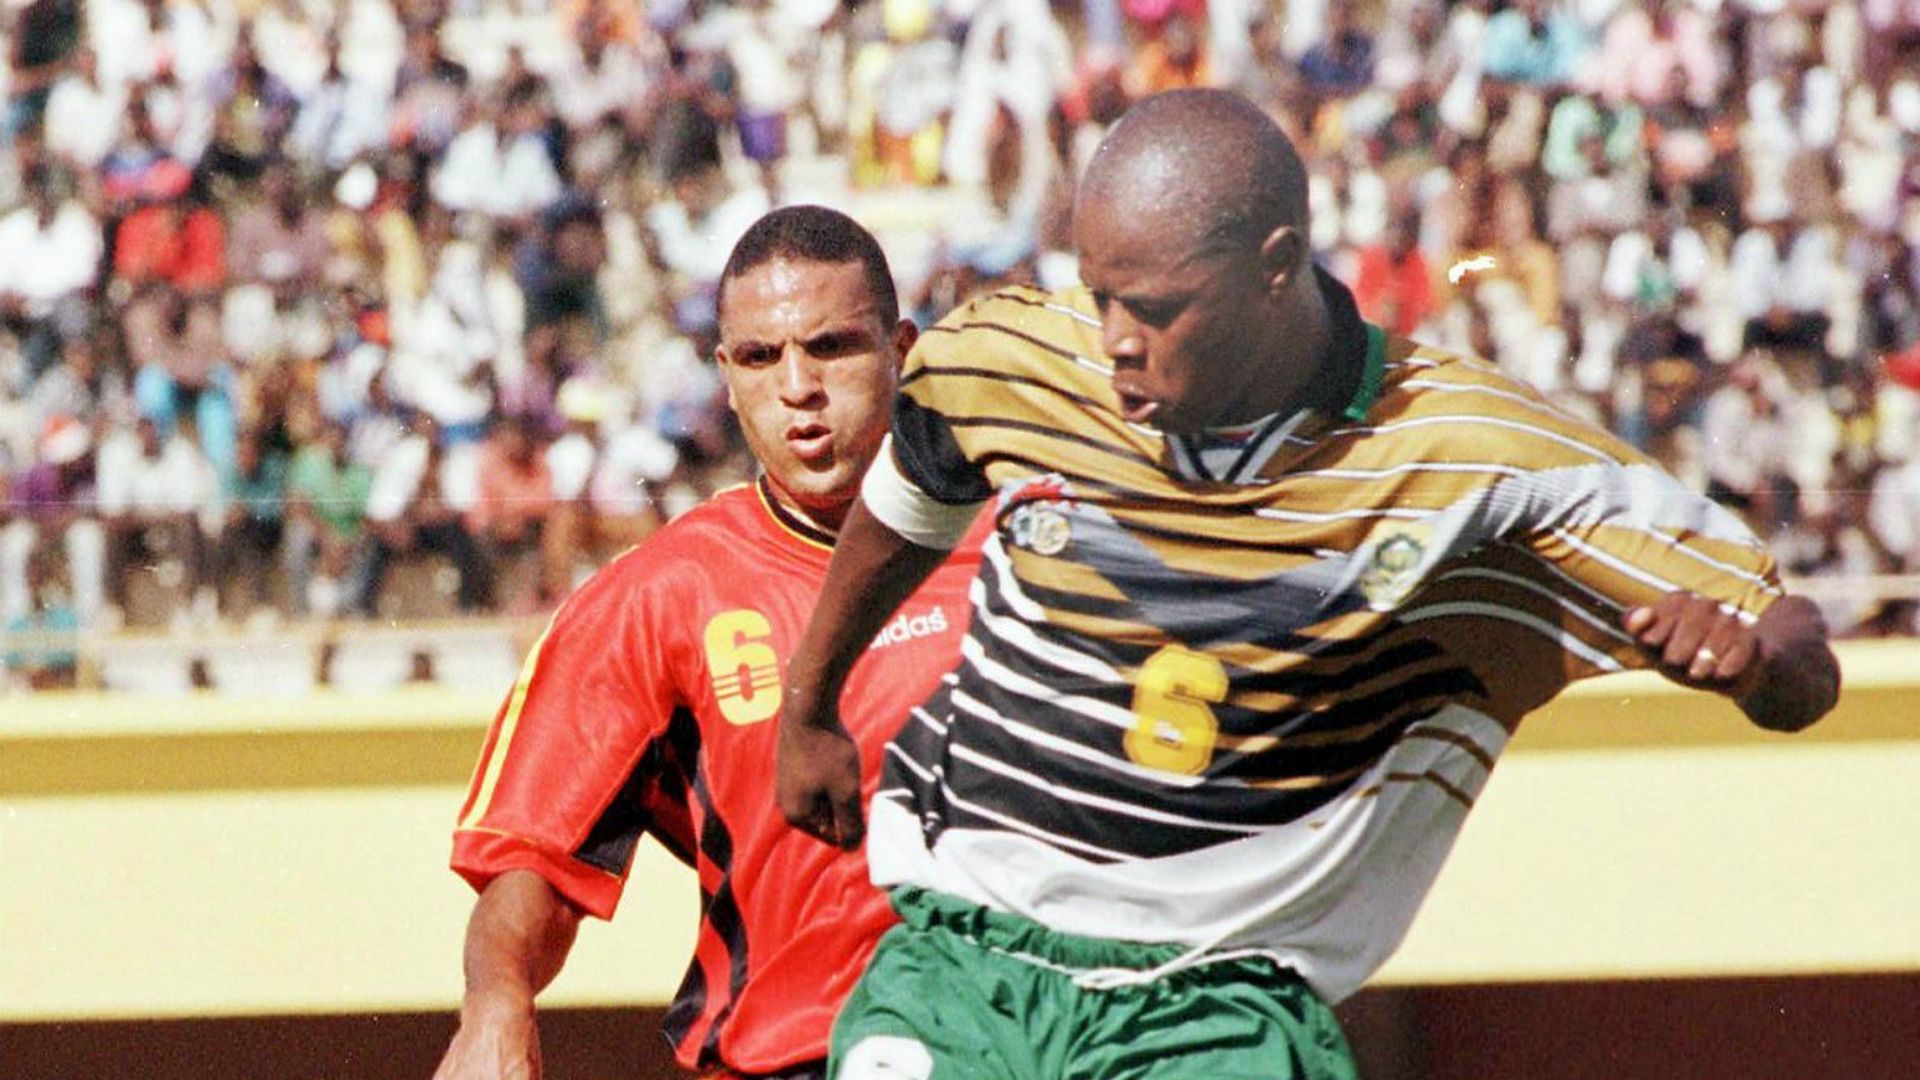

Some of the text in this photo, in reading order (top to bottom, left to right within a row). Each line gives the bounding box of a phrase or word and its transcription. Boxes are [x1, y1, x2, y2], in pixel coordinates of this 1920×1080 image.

[703, 608, 783, 726] 6
[869, 606, 949, 650] idas
[1123, 644, 1230, 777] 6
